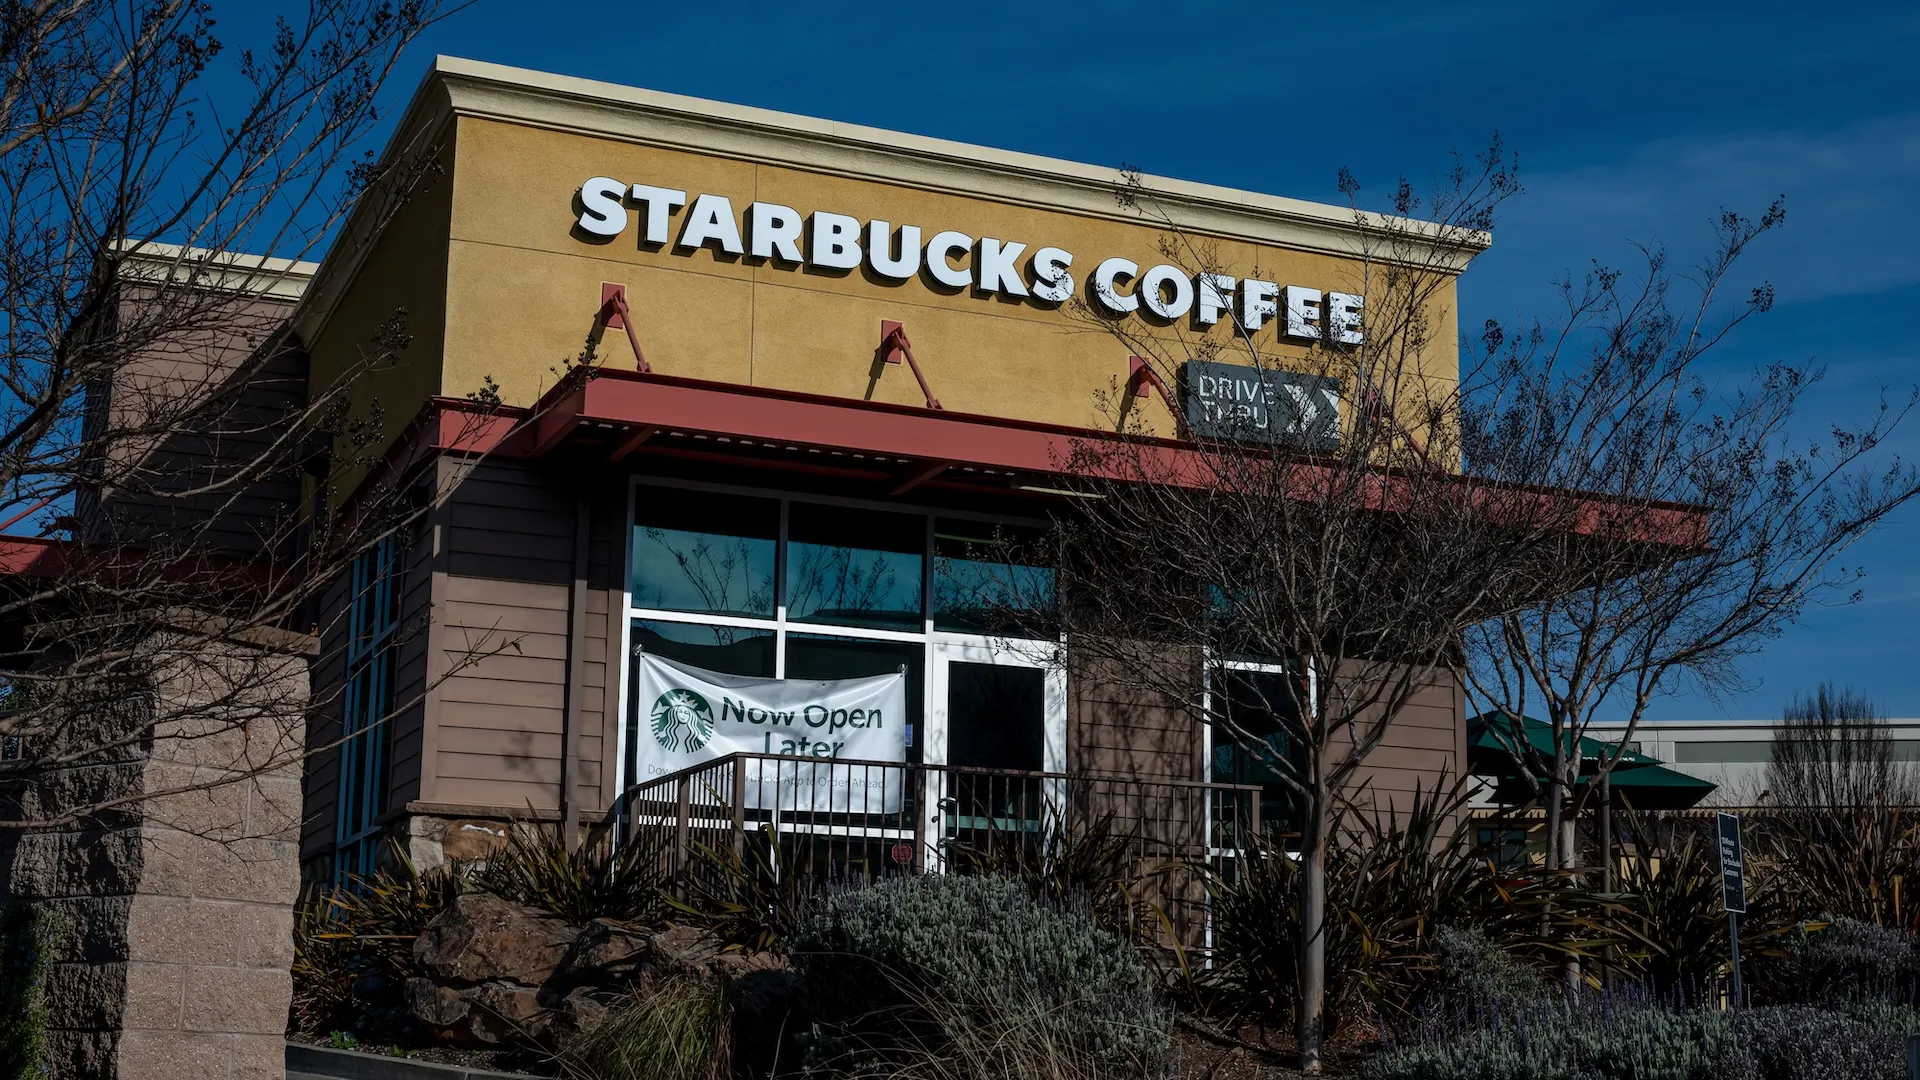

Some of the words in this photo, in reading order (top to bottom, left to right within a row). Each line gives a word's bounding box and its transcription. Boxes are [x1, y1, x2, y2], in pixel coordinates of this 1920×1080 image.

[578, 175, 1076, 302] STARBUCKS
[1094, 257, 1365, 345] COFFEE
[1199, 374, 1275, 405] DRIVE
[721, 696, 796, 727] Now
[803, 704, 883, 735] Open
[764, 731, 845, 759] Later
